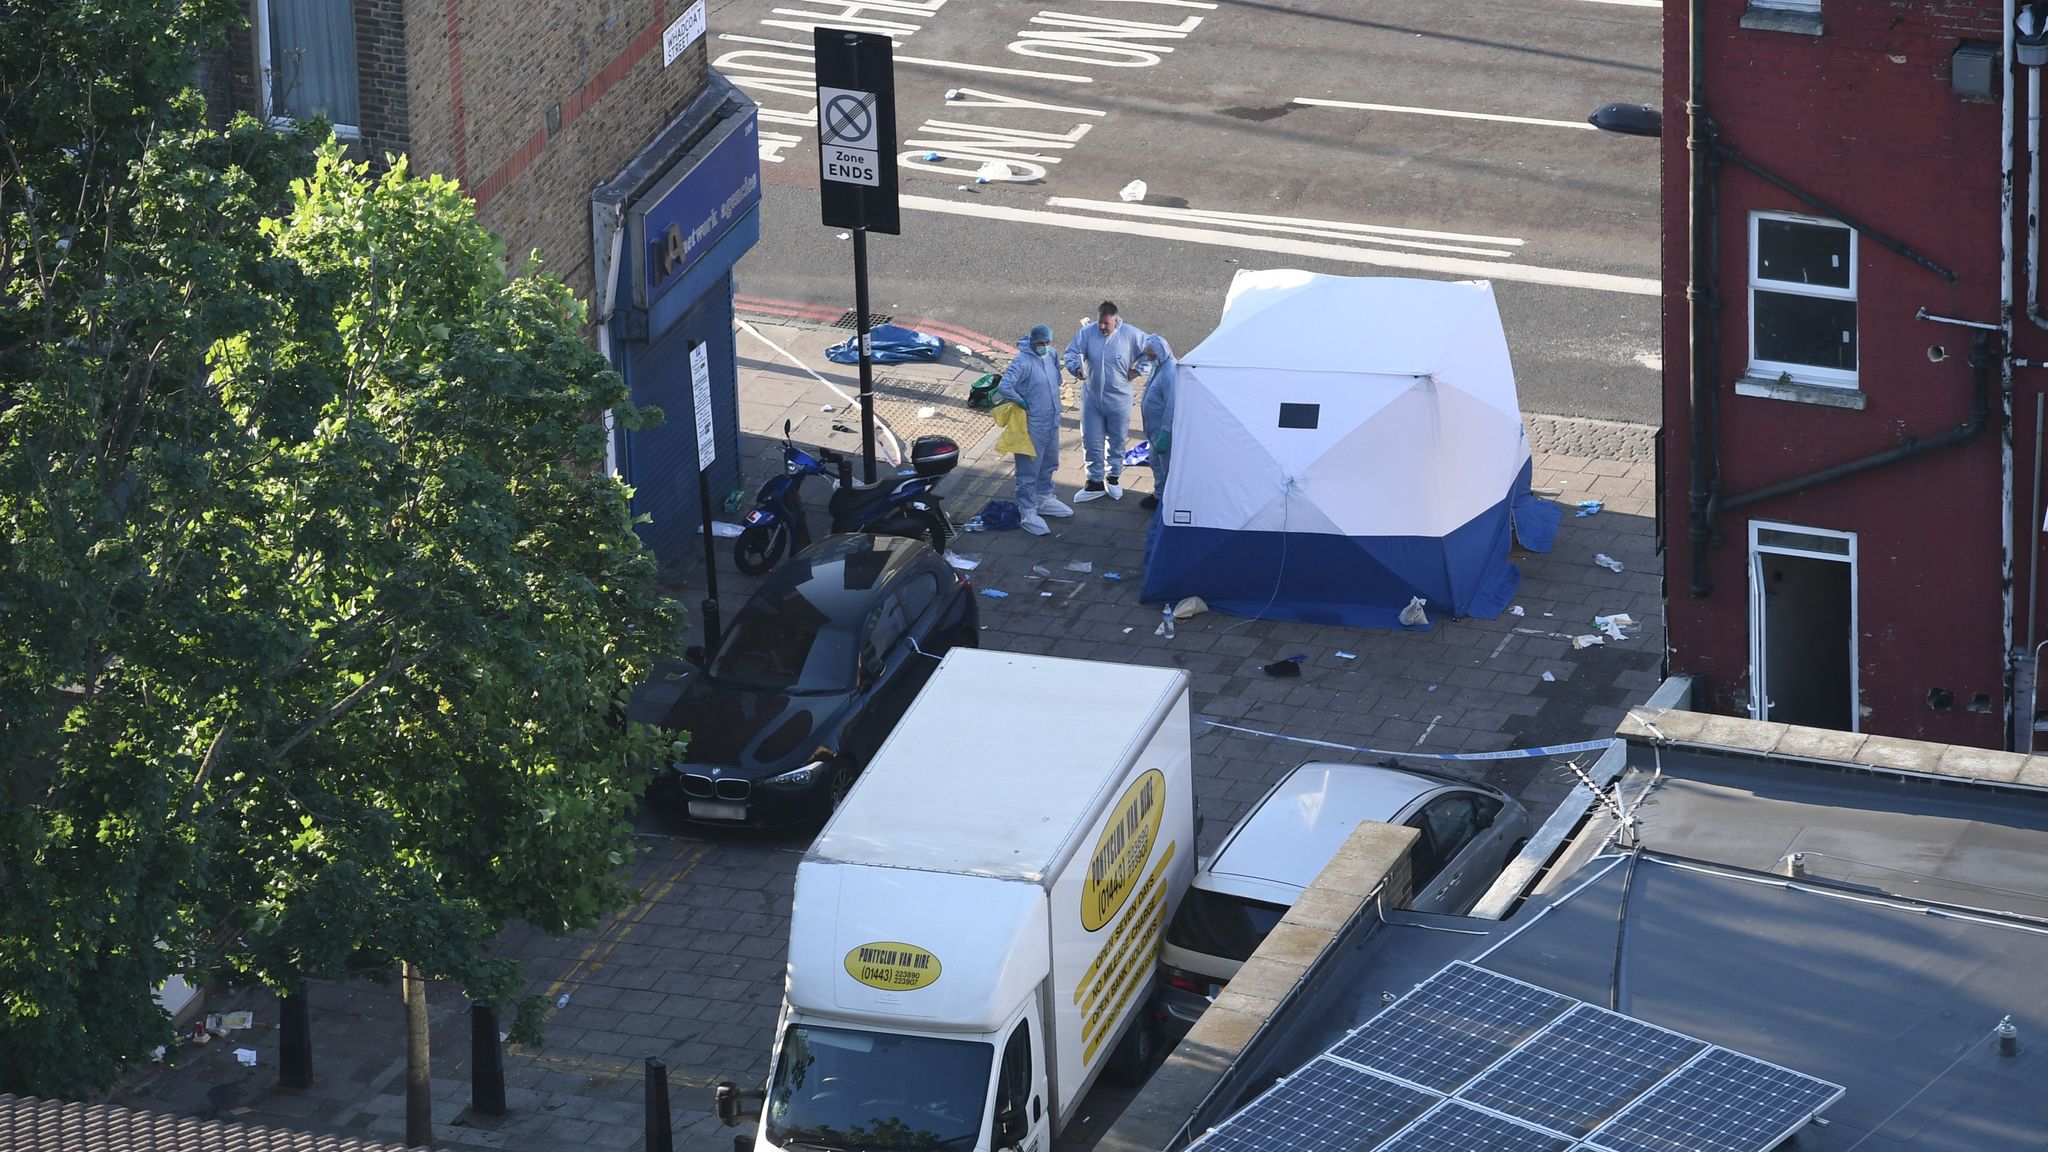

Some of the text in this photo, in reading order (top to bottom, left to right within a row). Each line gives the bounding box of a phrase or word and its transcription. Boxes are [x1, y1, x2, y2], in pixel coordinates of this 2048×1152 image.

[667, 8, 702, 48] WHADCOAT
[668, 32, 689, 61] STREET
[829, 163, 873, 180] ENDS
[836, 151, 865, 164] Zone
[1126, 798, 1139, 839] VAN
[1140, 776, 1154, 820] HIRE
[1095, 874, 1155, 969] OPEN SEVEN DAYS
[858, 947, 931, 969] PONTYCLUN VAN HIRE
[1092, 895, 1156, 999] NO MILEAGE CHARGE
[861, 965, 920, 983] (01443) 223890
[894, 977, 918, 986] 223907
[1092, 920, 1158, 1025] OPEN BANK HOLIDAYS
